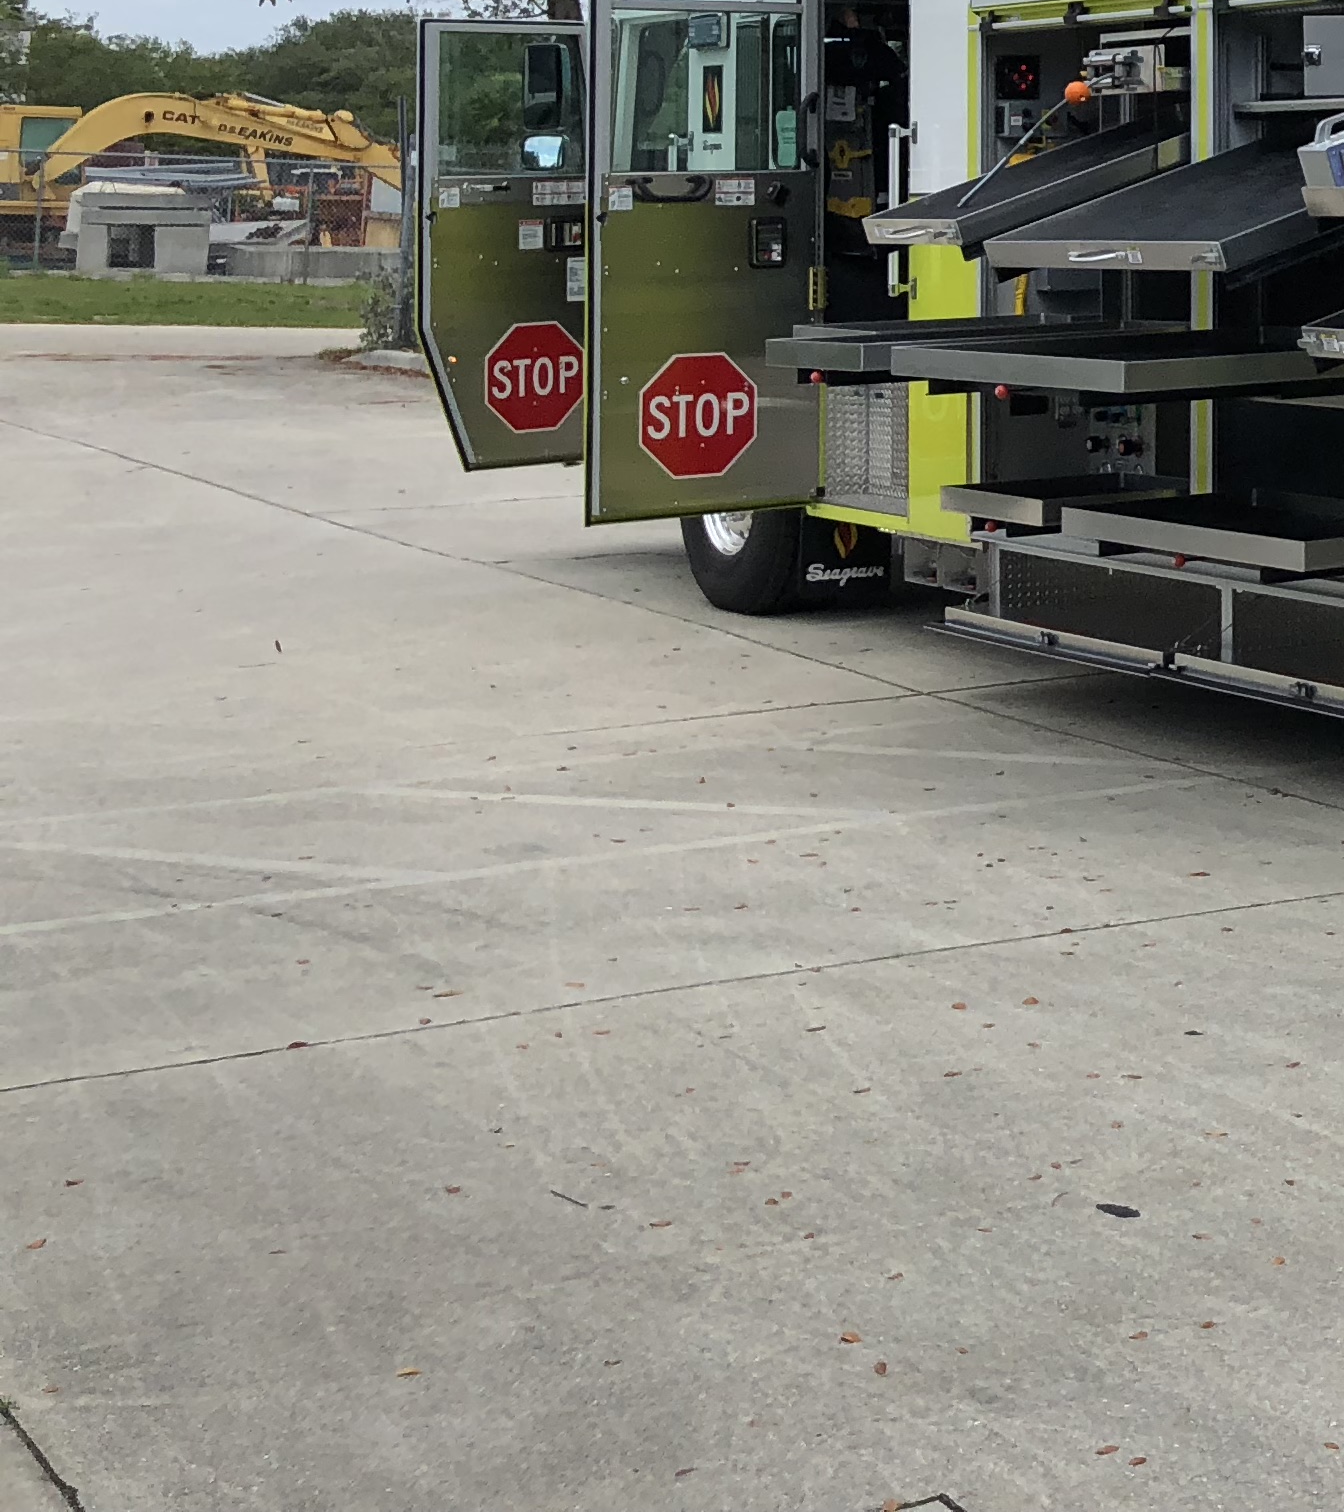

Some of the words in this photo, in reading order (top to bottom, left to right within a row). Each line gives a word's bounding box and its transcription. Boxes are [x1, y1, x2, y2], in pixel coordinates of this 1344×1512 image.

[162, 110, 200, 125] CAT
[491, 355, 579, 400] STOP
[647, 392, 750, 440] STOP
[805, 563, 885, 587] Seagrave
